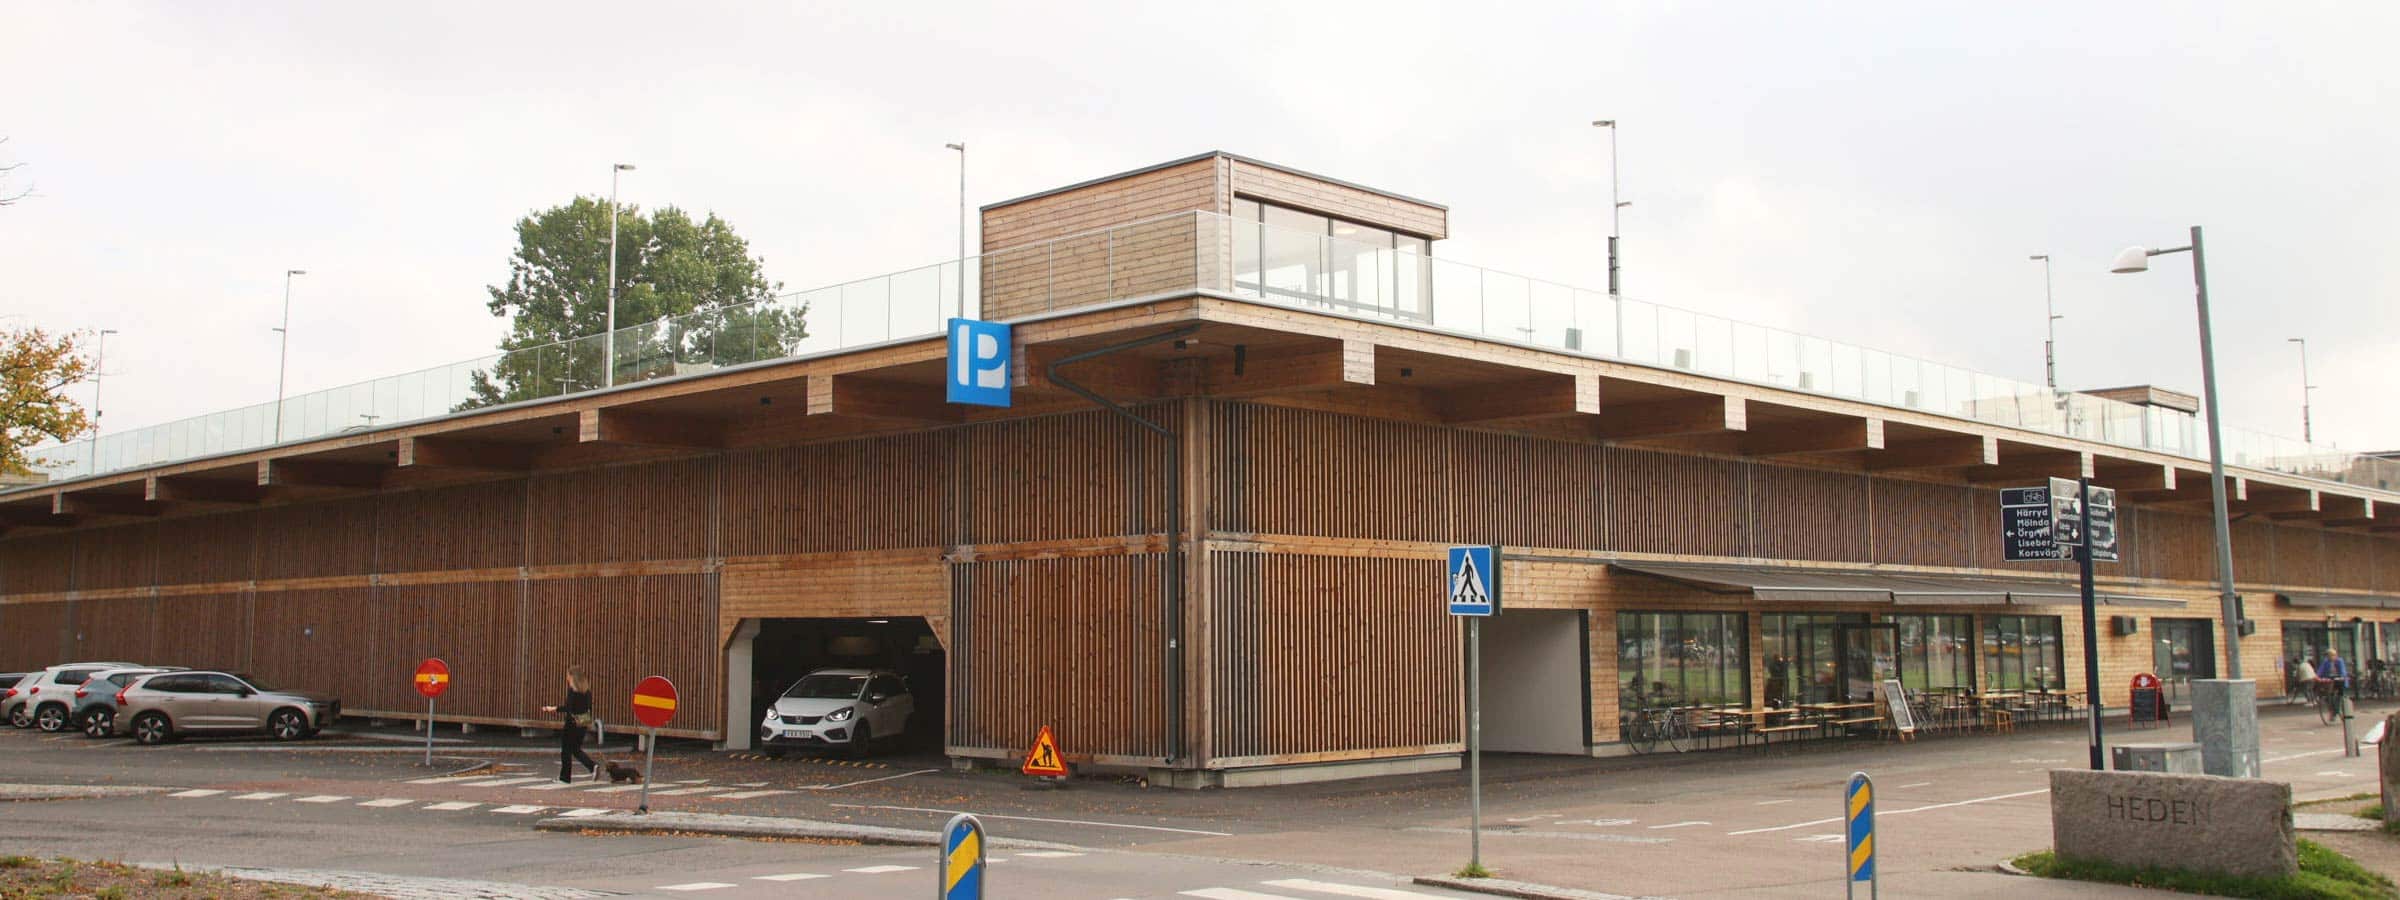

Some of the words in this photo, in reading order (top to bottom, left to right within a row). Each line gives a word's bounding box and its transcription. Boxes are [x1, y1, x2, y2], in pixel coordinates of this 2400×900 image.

[2017, 509, 2048, 518] Härryd
[2017, 519, 2049, 527] Mölnda
[2018, 540, 2056, 548] Liseber
[2018, 548, 2061, 558] Korsväg
[2106, 794, 2212, 826] HEDEN
